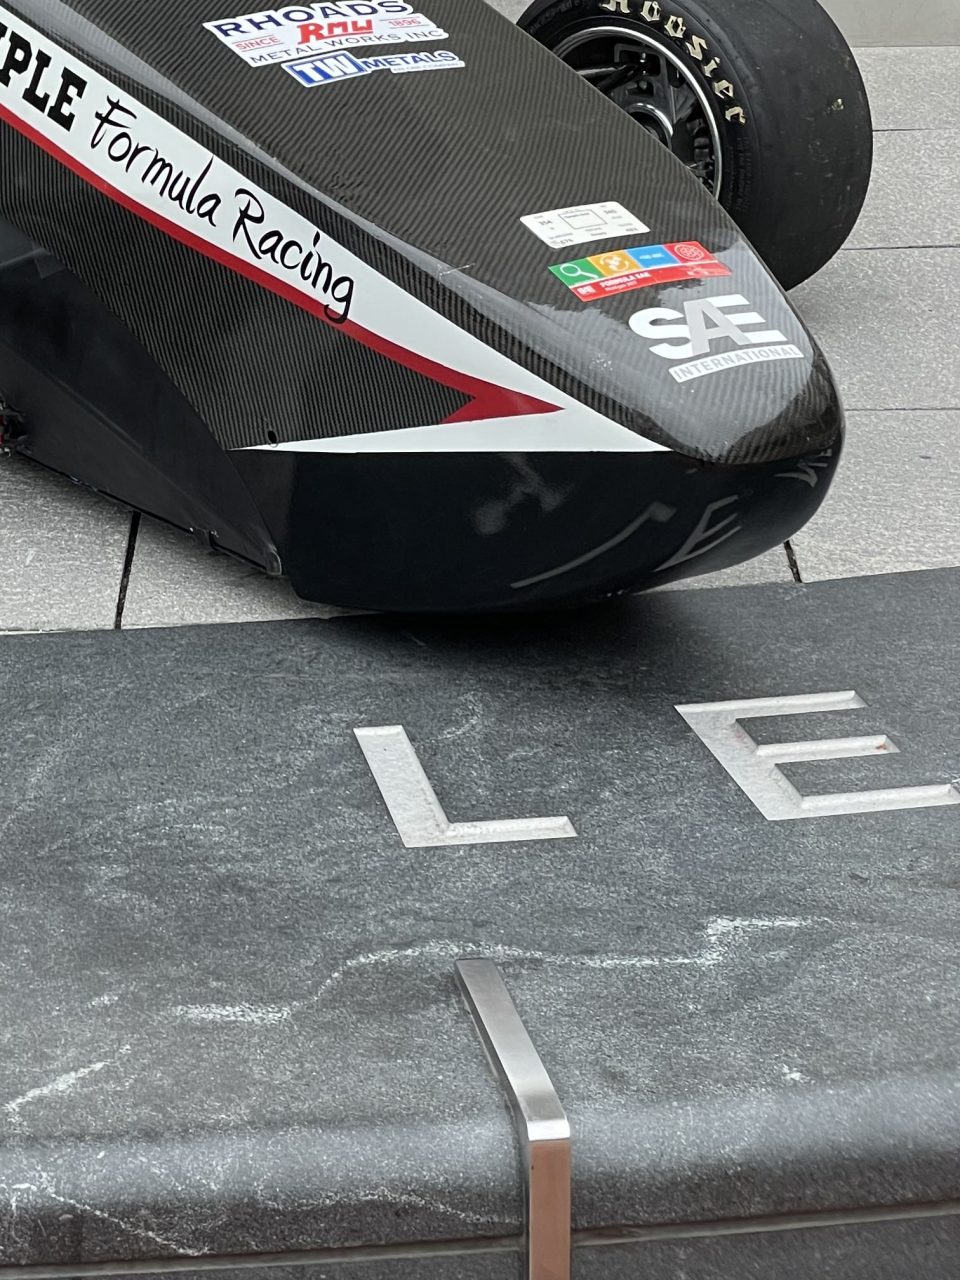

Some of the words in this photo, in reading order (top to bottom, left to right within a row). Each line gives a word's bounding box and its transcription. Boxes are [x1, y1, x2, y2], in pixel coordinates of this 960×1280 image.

[212, 0, 409, 37] RHOADS
[234, 36, 281, 51] SINCE
[249, 45, 323, 64] METAL
[325, 33, 402, 48] WORKS
[405, 29, 443, 40] INC
[292, 54, 361, 83] TW
[360, 51, 458, 69] METALS
[87, 94, 224, 227] Formula
[232, 188, 355, 324] Racing
[628, 293, 788, 360] SAE
[672, 344, 801, 381] INTERNATIONAL
